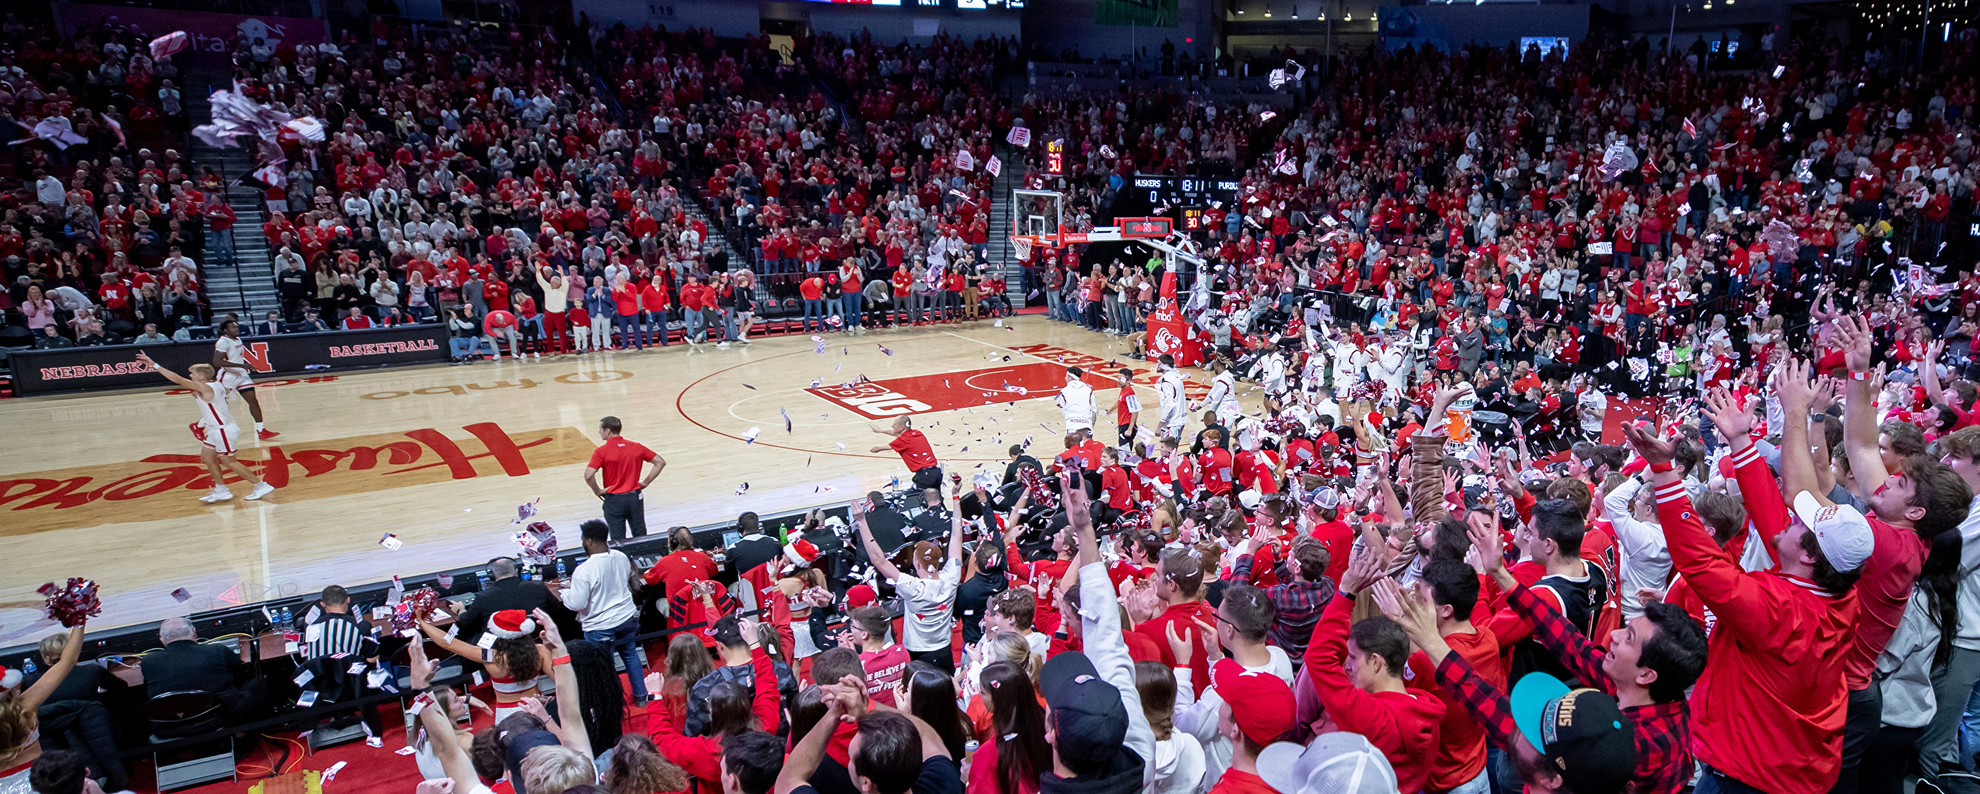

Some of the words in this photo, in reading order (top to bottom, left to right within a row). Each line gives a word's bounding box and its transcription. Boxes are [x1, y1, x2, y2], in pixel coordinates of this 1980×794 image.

[649, 5, 673, 15] 119
[1135, 179, 1161, 187] HUSKERS
[1182, 179, 1205, 191] 18:11
[1218, 181, 1238, 190] PURDU
[1150, 190, 1158, 203] 0
[1187, 218, 1198, 229] 30
[106, 290, 118, 300] N
[1155, 309, 1172, 322] fnbo
[329, 339, 439, 358] BASKETBALL
[40, 360, 160, 381] NEBRASKA
[359, 378, 544, 400] fnbo
[0, 422, 553, 511] Huskers
[874, 664, 900, 679] BELIEVE
